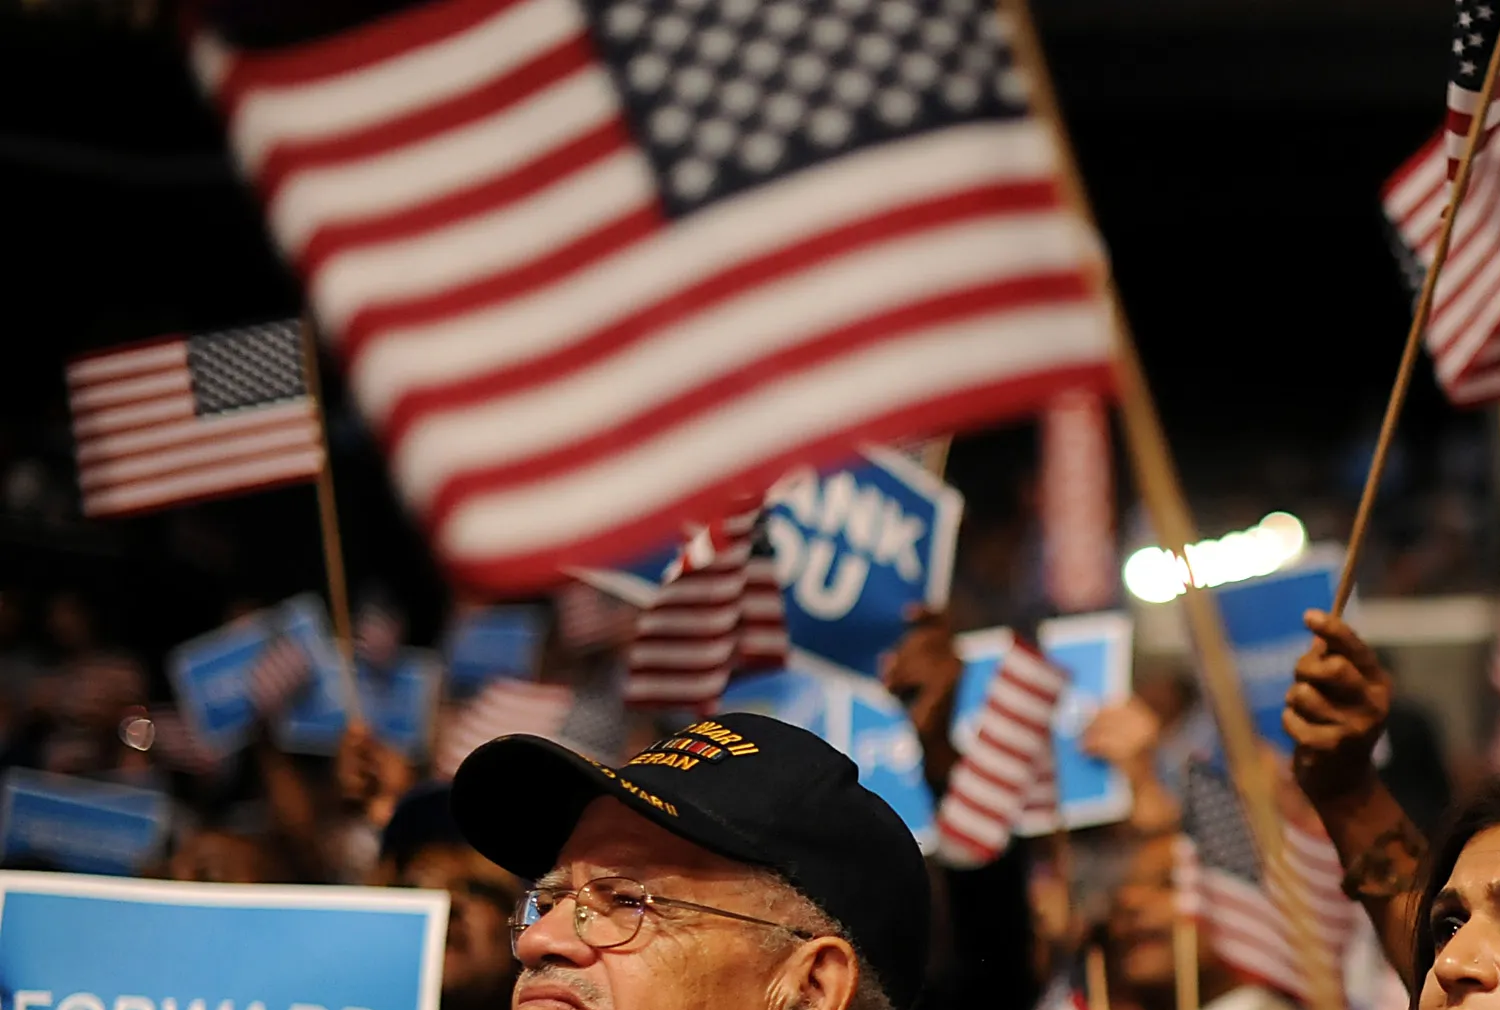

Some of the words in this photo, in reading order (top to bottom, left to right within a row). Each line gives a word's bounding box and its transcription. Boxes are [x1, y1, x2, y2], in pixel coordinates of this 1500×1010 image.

[764, 467, 926, 581] ANK
[689, 721, 742, 745] WAR
[718, 742, 759, 756] II
